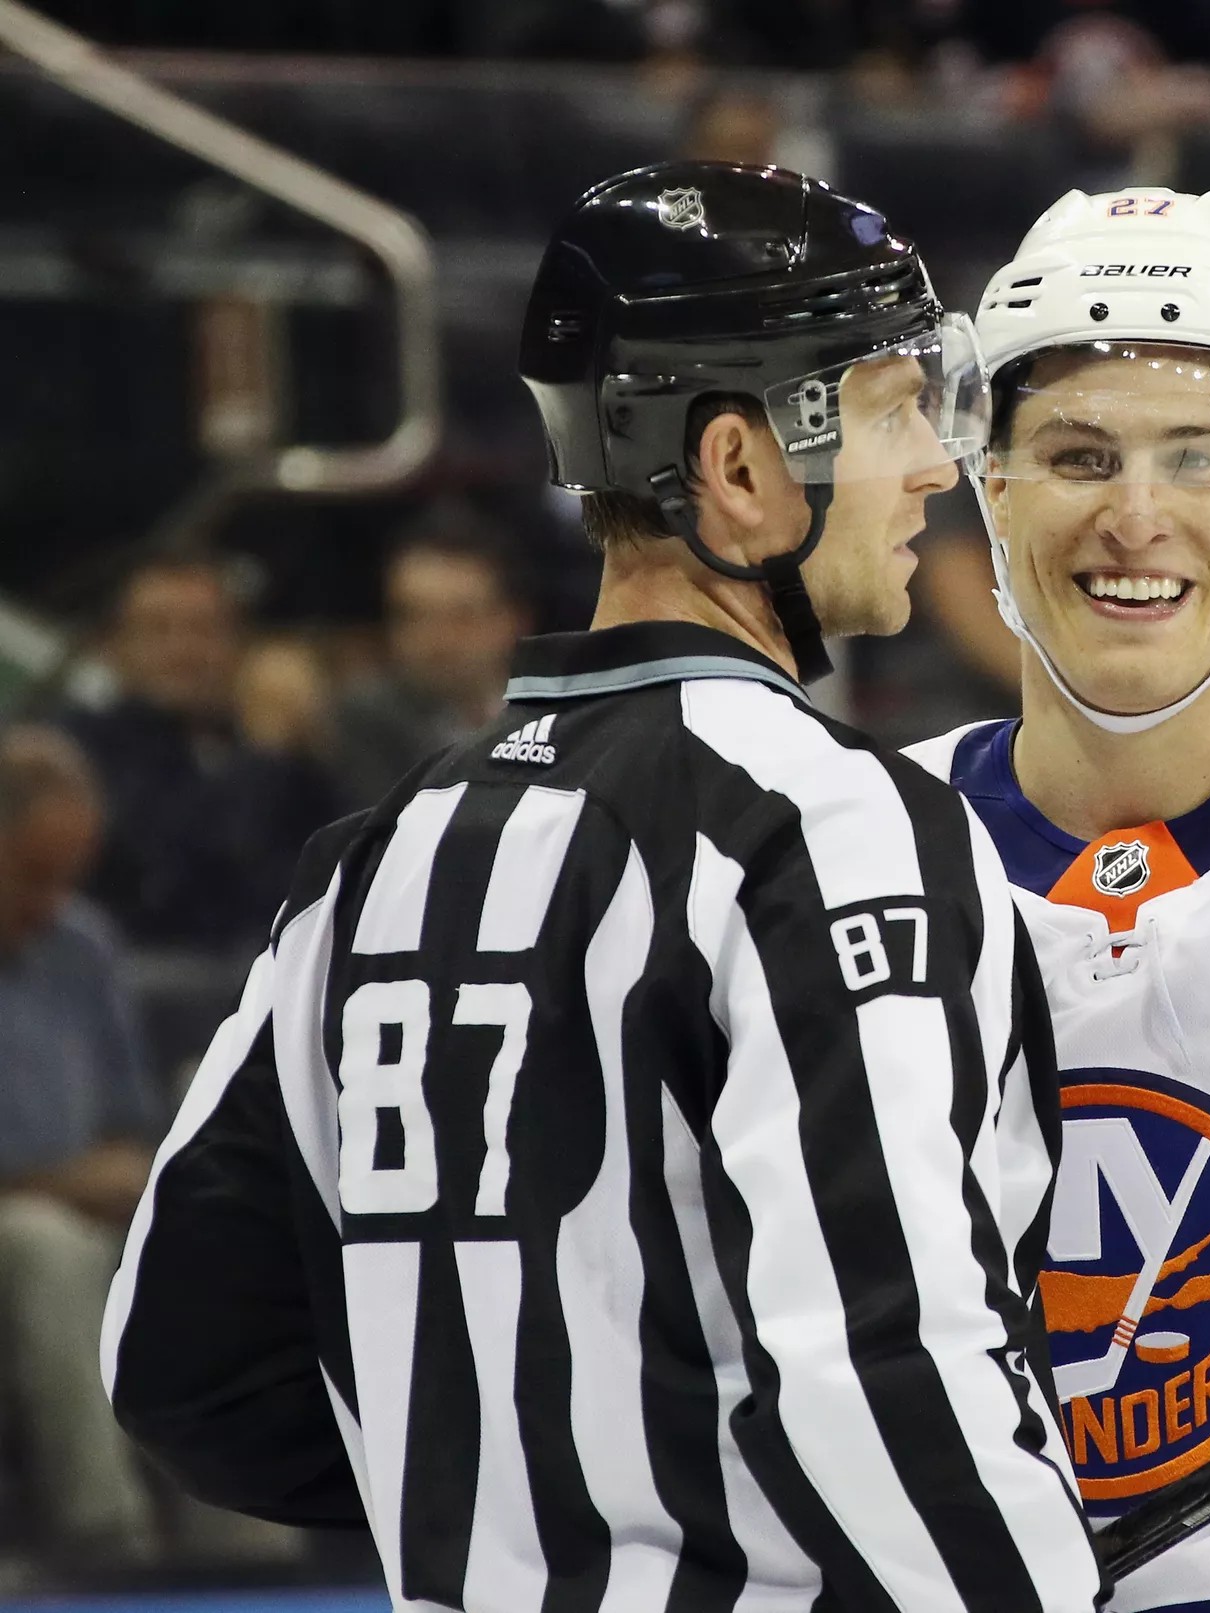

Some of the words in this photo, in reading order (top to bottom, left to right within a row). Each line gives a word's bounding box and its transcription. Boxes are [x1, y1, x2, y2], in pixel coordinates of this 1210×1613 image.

[670, 195, 694, 220] NHL
[1107, 198, 1175, 218] 27
[490, 739, 556, 764] adidas
[1105, 853, 1138, 884] NHL
[829, 907, 928, 991] 87
[338, 978, 533, 1217] 87
